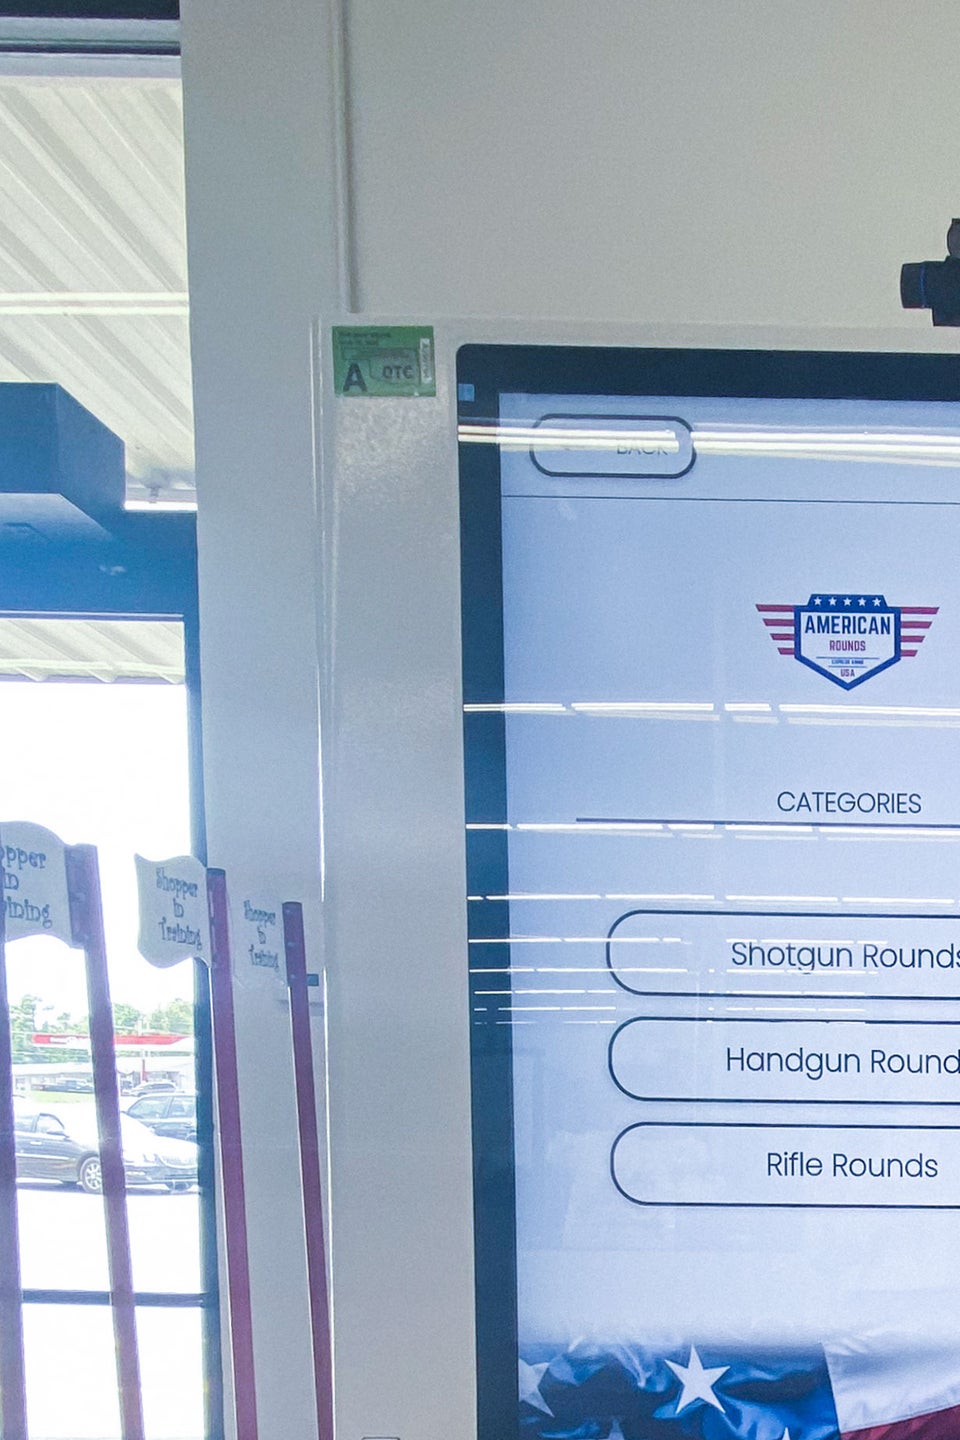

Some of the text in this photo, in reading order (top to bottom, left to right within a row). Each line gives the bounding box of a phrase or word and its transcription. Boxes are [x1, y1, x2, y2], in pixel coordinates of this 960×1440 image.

[804, 615, 891, 634] AMERICAN
[829, 640, 866, 651] ROUNDS
[840, 669, 855, 677] USA
[777, 791, 922, 814] CATEGORIES
[731, 941, 853, 975] Shotgun
[726, 1047, 861, 1081] Handgun
[767, 1152, 939, 1178] Rifle Rounds
